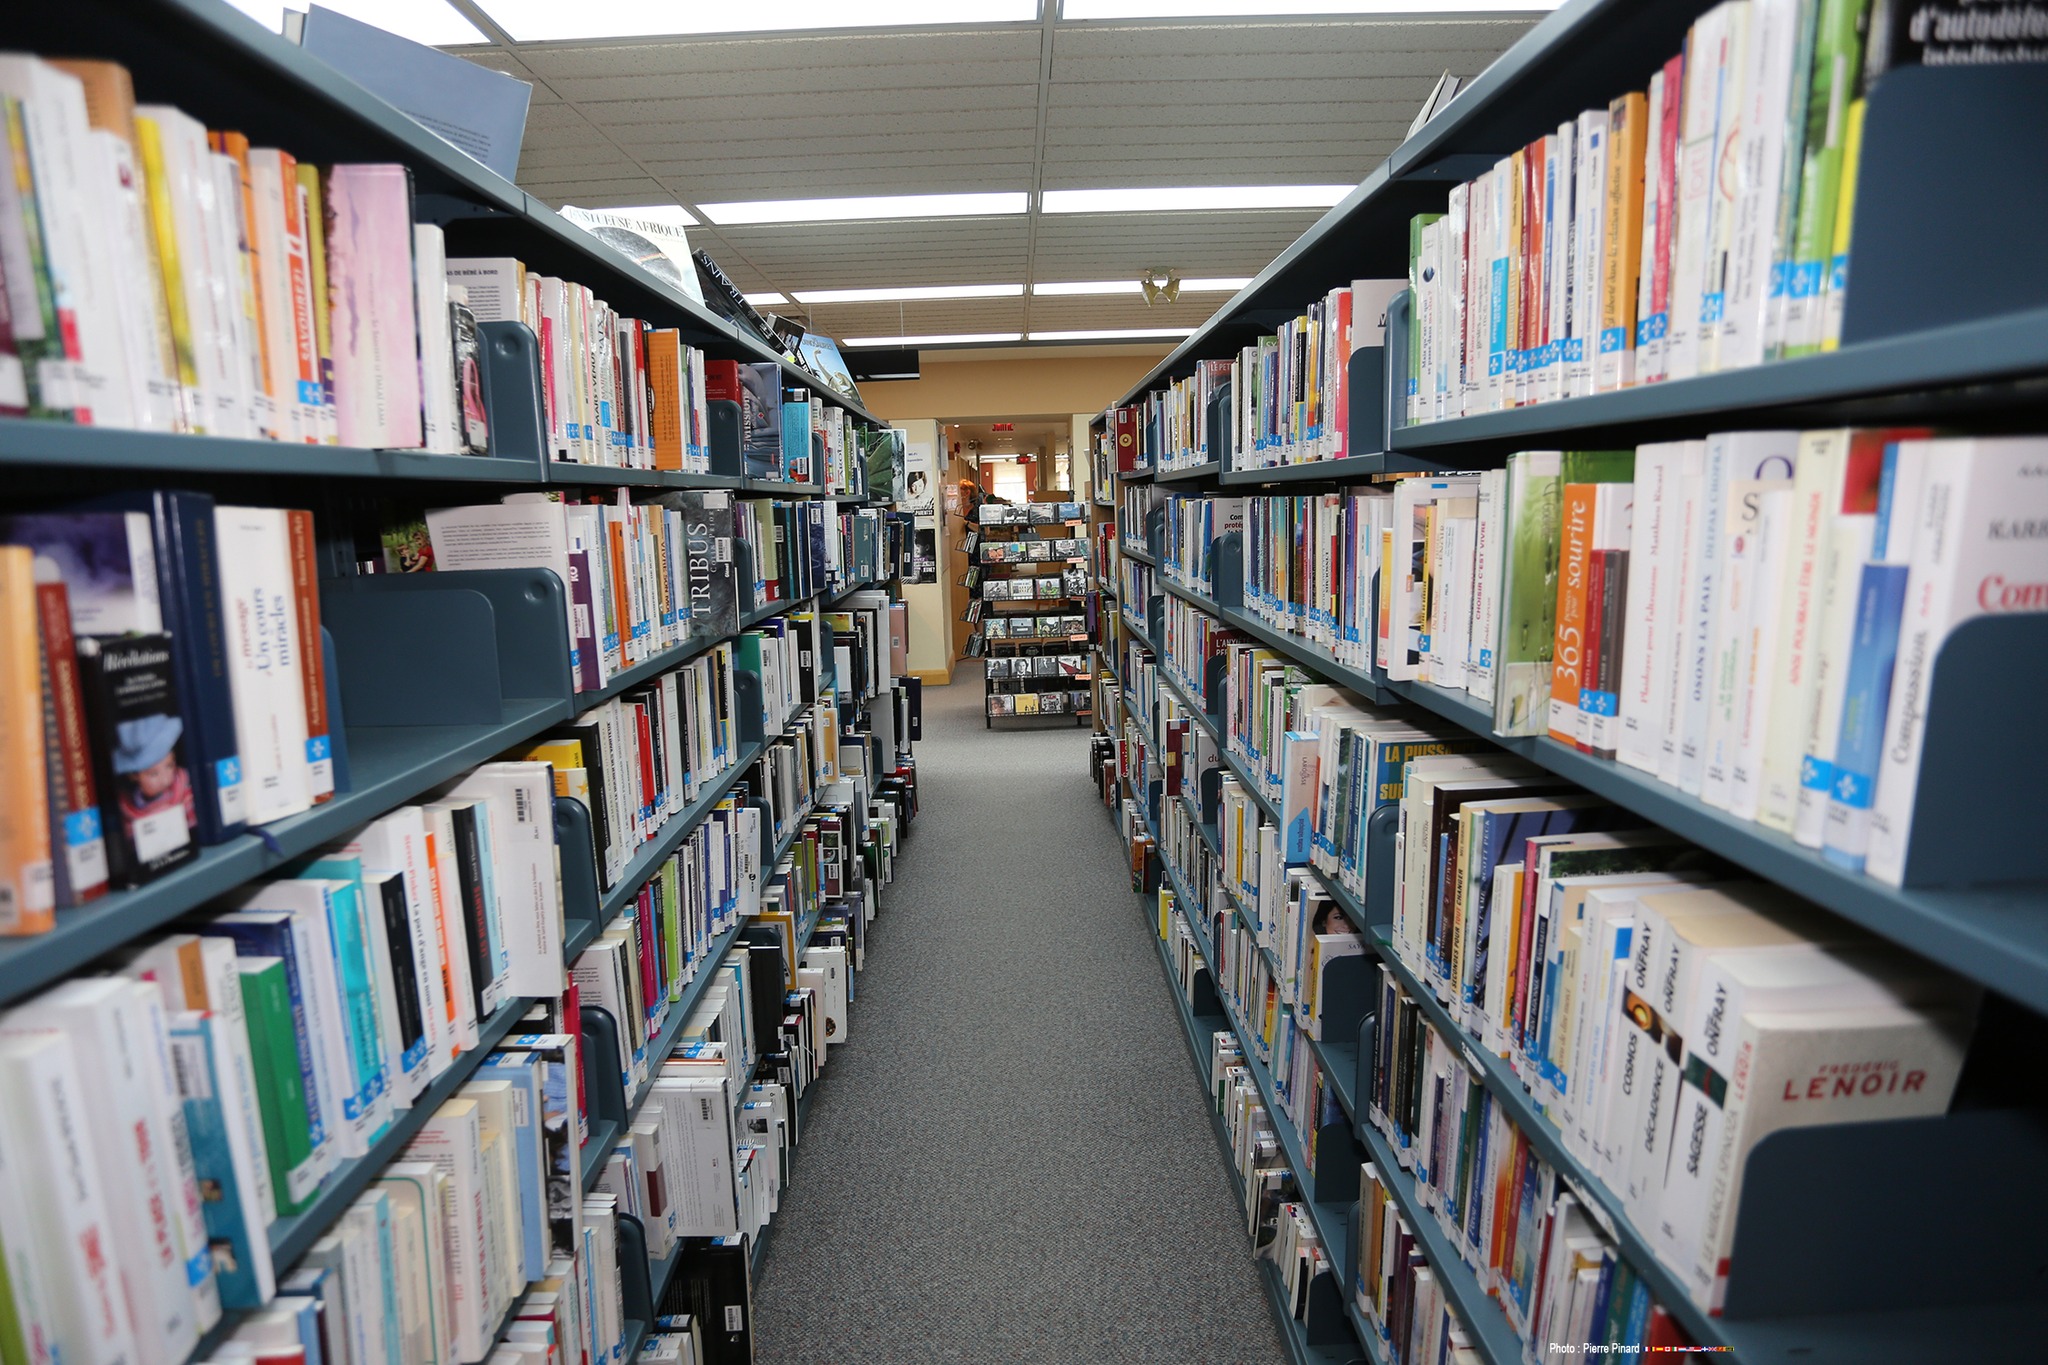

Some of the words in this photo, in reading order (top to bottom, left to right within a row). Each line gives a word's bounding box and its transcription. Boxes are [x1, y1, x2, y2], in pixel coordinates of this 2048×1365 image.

[634, 219, 683, 238] AFRIQUE
[701, 252, 745, 308] TRAINS
[592, 393, 600, 426] MARS
[1653, 465, 1664, 502] Ricard
[1708, 444, 1722, 503] CHOPRA
[1567, 500, 1586, 589] sourire
[1650, 505, 1662, 556] Matthieu
[1704, 507, 1719, 560] DEEPAK
[570, 566, 579, 582] KO
[686, 522, 712, 619] TRIBUS
[1793, 589, 1811, 650] POURRAIT
[1804, 491, 1822, 539] MONDE
[251, 588, 268, 636] cours
[1432, 590, 1440, 619] bonheur
[1475, 582, 1483, 620] CHOISIR
[1570, 595, 1579, 618] pour
[1645, 565, 1657, 622] l'altruisme
[1699, 574, 1712, 613] PAIX
[235, 597, 252, 658] message
[270, 595, 291, 666] miracles
[1643, 625, 1654, 650] pour
[1697, 619, 1708, 640] LA
[1556, 623, 1582, 687] 365
[1692, 645, 1706, 702] OSONS
[1890, 629, 1930, 765] Compassion
[1300, 756, 1308, 786] LAROUSSE
[1385, 745, 1401, 762] LA
[1328, 821, 1333, 830] Le
[1482, 819, 1491, 845] PECK
[471, 862, 479, 882] David
[1480, 848, 1489, 881] SCOTT
[408, 868, 420, 902] Pinker
[1455, 868, 1465, 906] CHANGER
[473, 885, 486, 938] REVENANTS
[479, 940, 488, 958] LES
[1453, 927, 1461, 948] POUR
[1450, 949, 1460, 987] SECONDES
[1562, 987, 1571, 1014] merci
[1621, 1031, 1639, 1096] COSMOS
[1634, 921, 1653, 989] ONFRAY
[1558, 1015, 1568, 1033] dire
[1643, 1057, 1666, 1154] DÉCADENCE
[1662, 943, 1682, 1014] ONFRAY
[1685, 1101, 1708, 1178] SAGESSE
[1703, 983, 1729, 1056] ONFRAY
[1733, 1040, 1754, 1102] LENOIR
[1783, 1070, 1928, 1101] LENOIR
[1715, 1107, 1739, 1171] SPINOZA
[472, 1190, 484, 1229] VIRILITÉ
[1468, 1207, 1477, 1237] Pérou
[1473, 1161, 1481, 1188] chemins
[1705, 1173, 1729, 1239] MIRACLE
[478, 1261, 489, 1296] MYTHE
